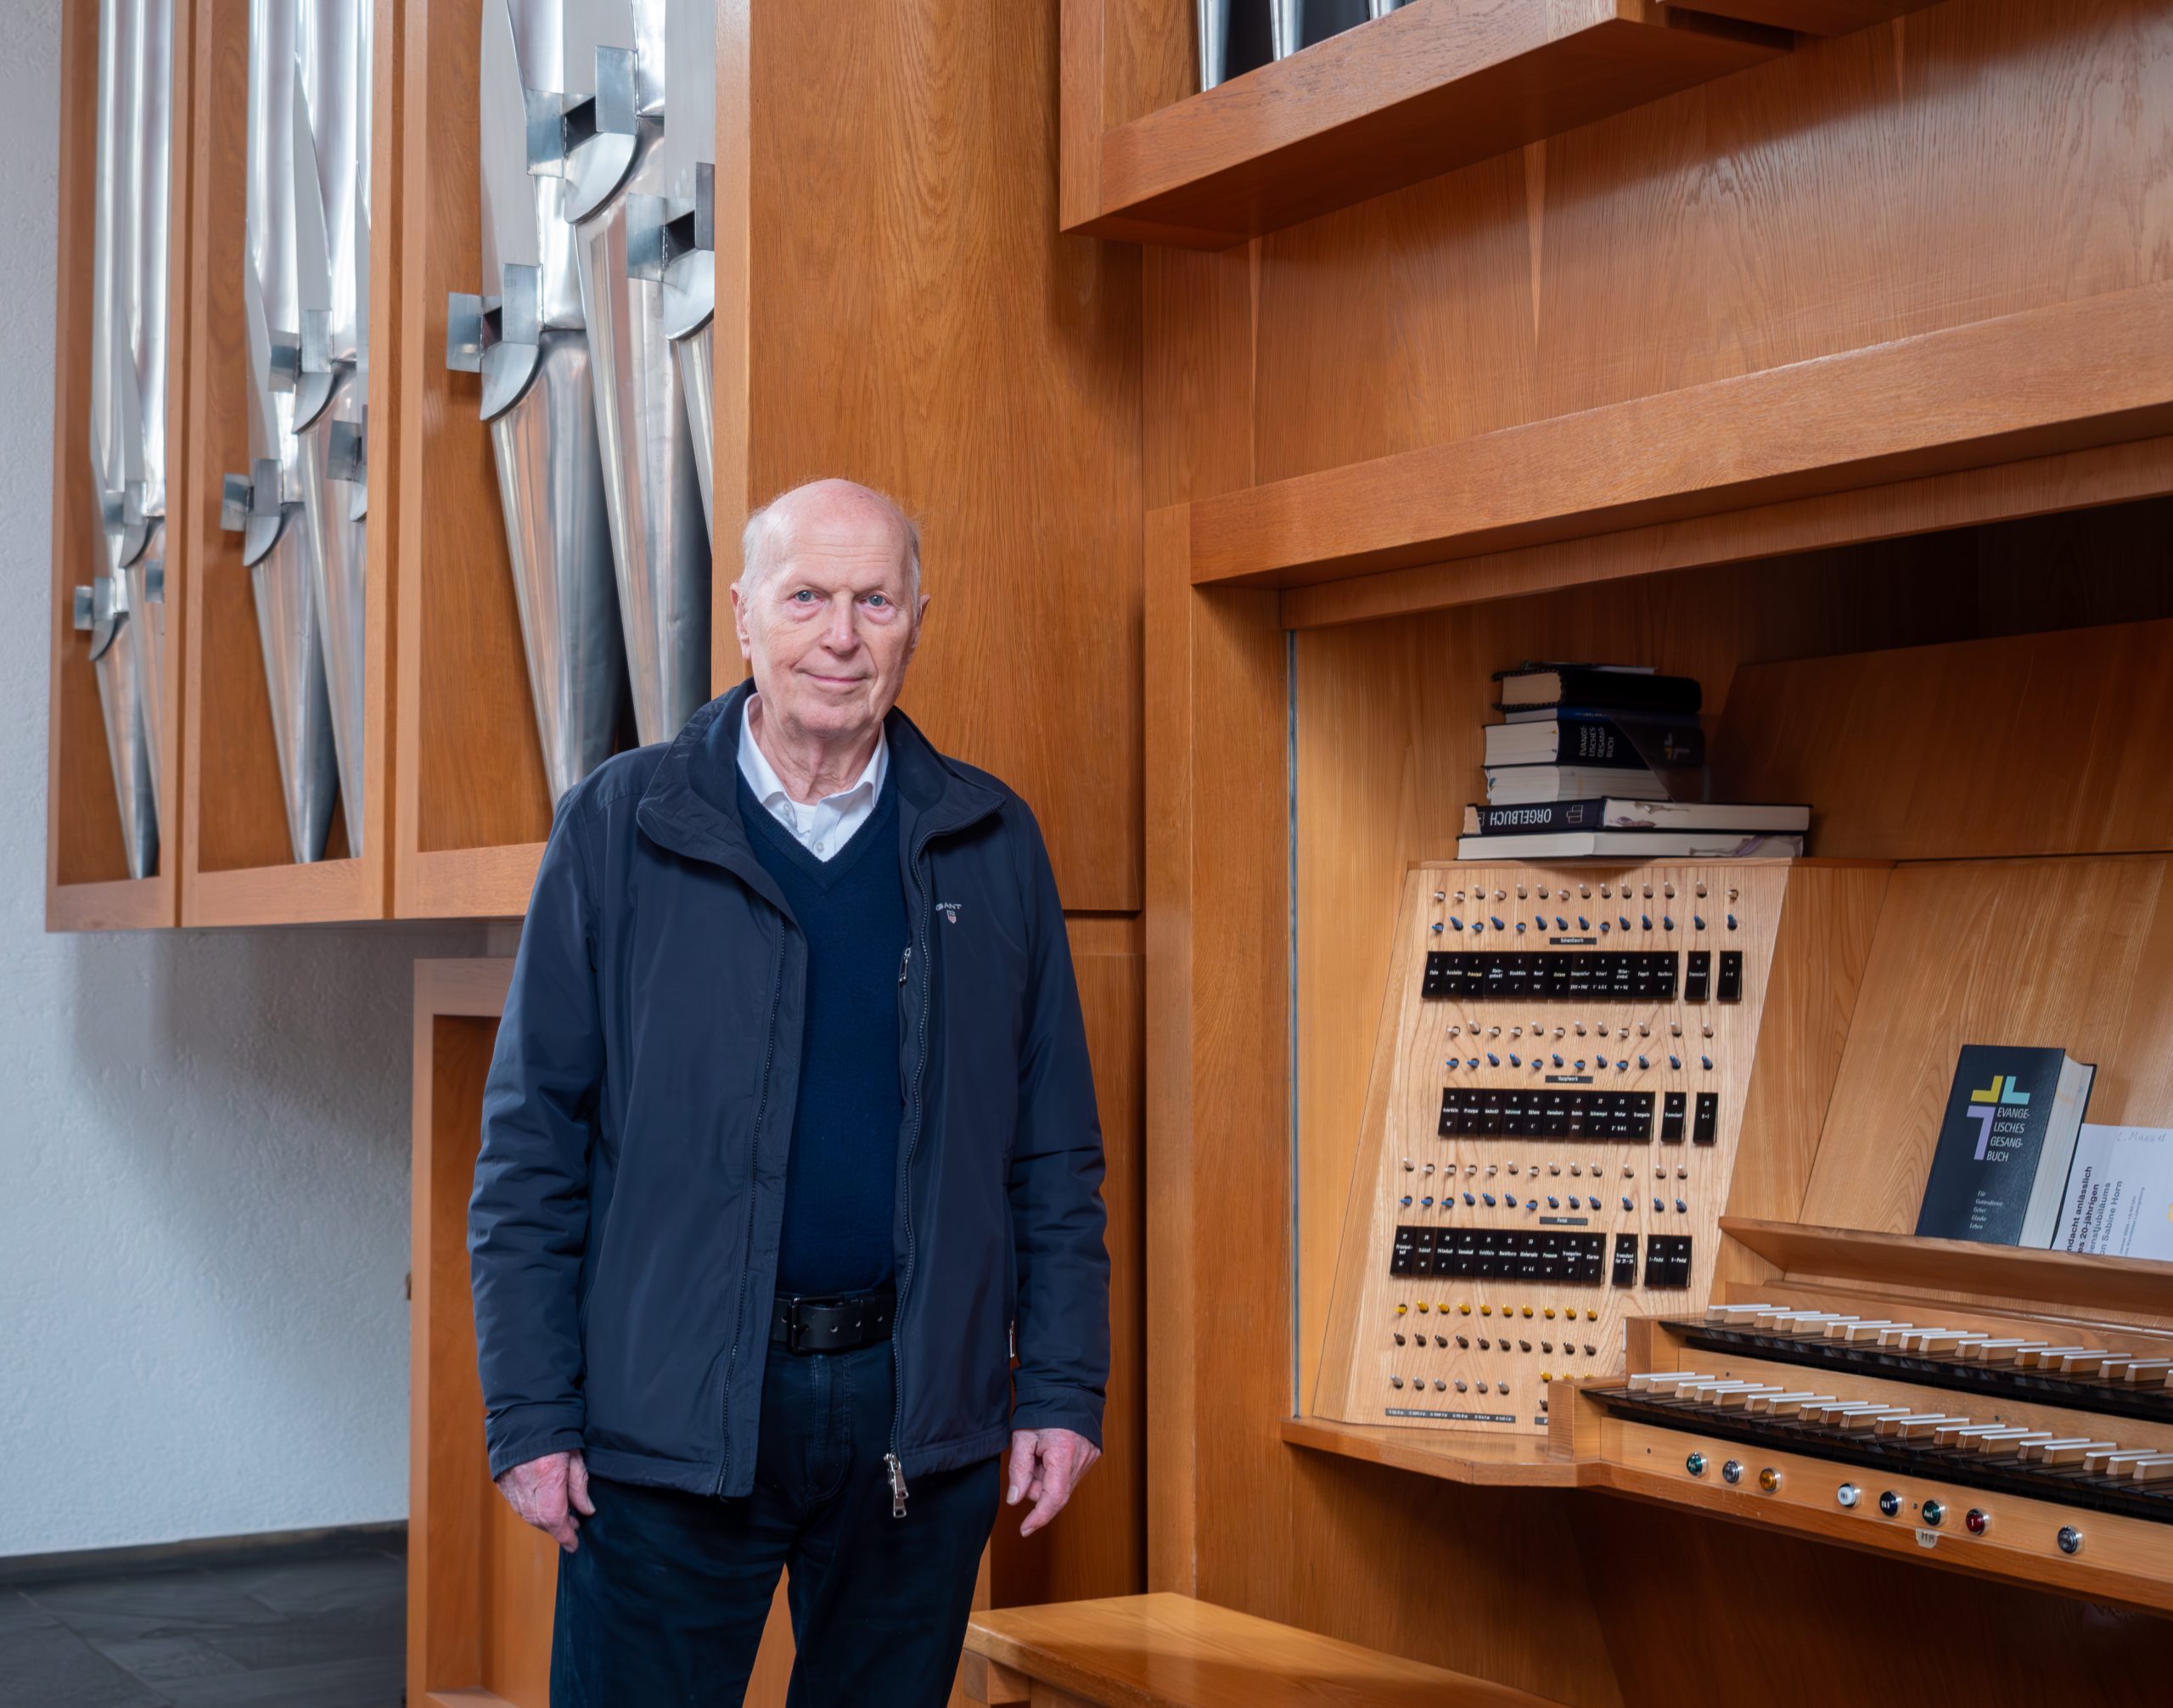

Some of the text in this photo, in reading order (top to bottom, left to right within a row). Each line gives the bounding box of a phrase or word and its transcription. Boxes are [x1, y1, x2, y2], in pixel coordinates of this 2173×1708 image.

[1490, 808, 1552, 827] ORGELBUCH
[1997, 1107, 2030, 1119] EVANGE-
[1993, 1121, 2025, 1133] LISCHES
[1990, 1136, 2024, 1148] GESANG-
[1986, 1150, 2009, 1161] BUCH
[2067, 1166, 2092, 1251] ndacht anlässlich
[2080, 1183, 2100, 1239] 20-jährigen
[2089, 1183, 2111, 1253] ienstjubiläums
[2102, 1207, 2116, 1242] Sabine
[2111, 1181, 2123, 1205] Horn
